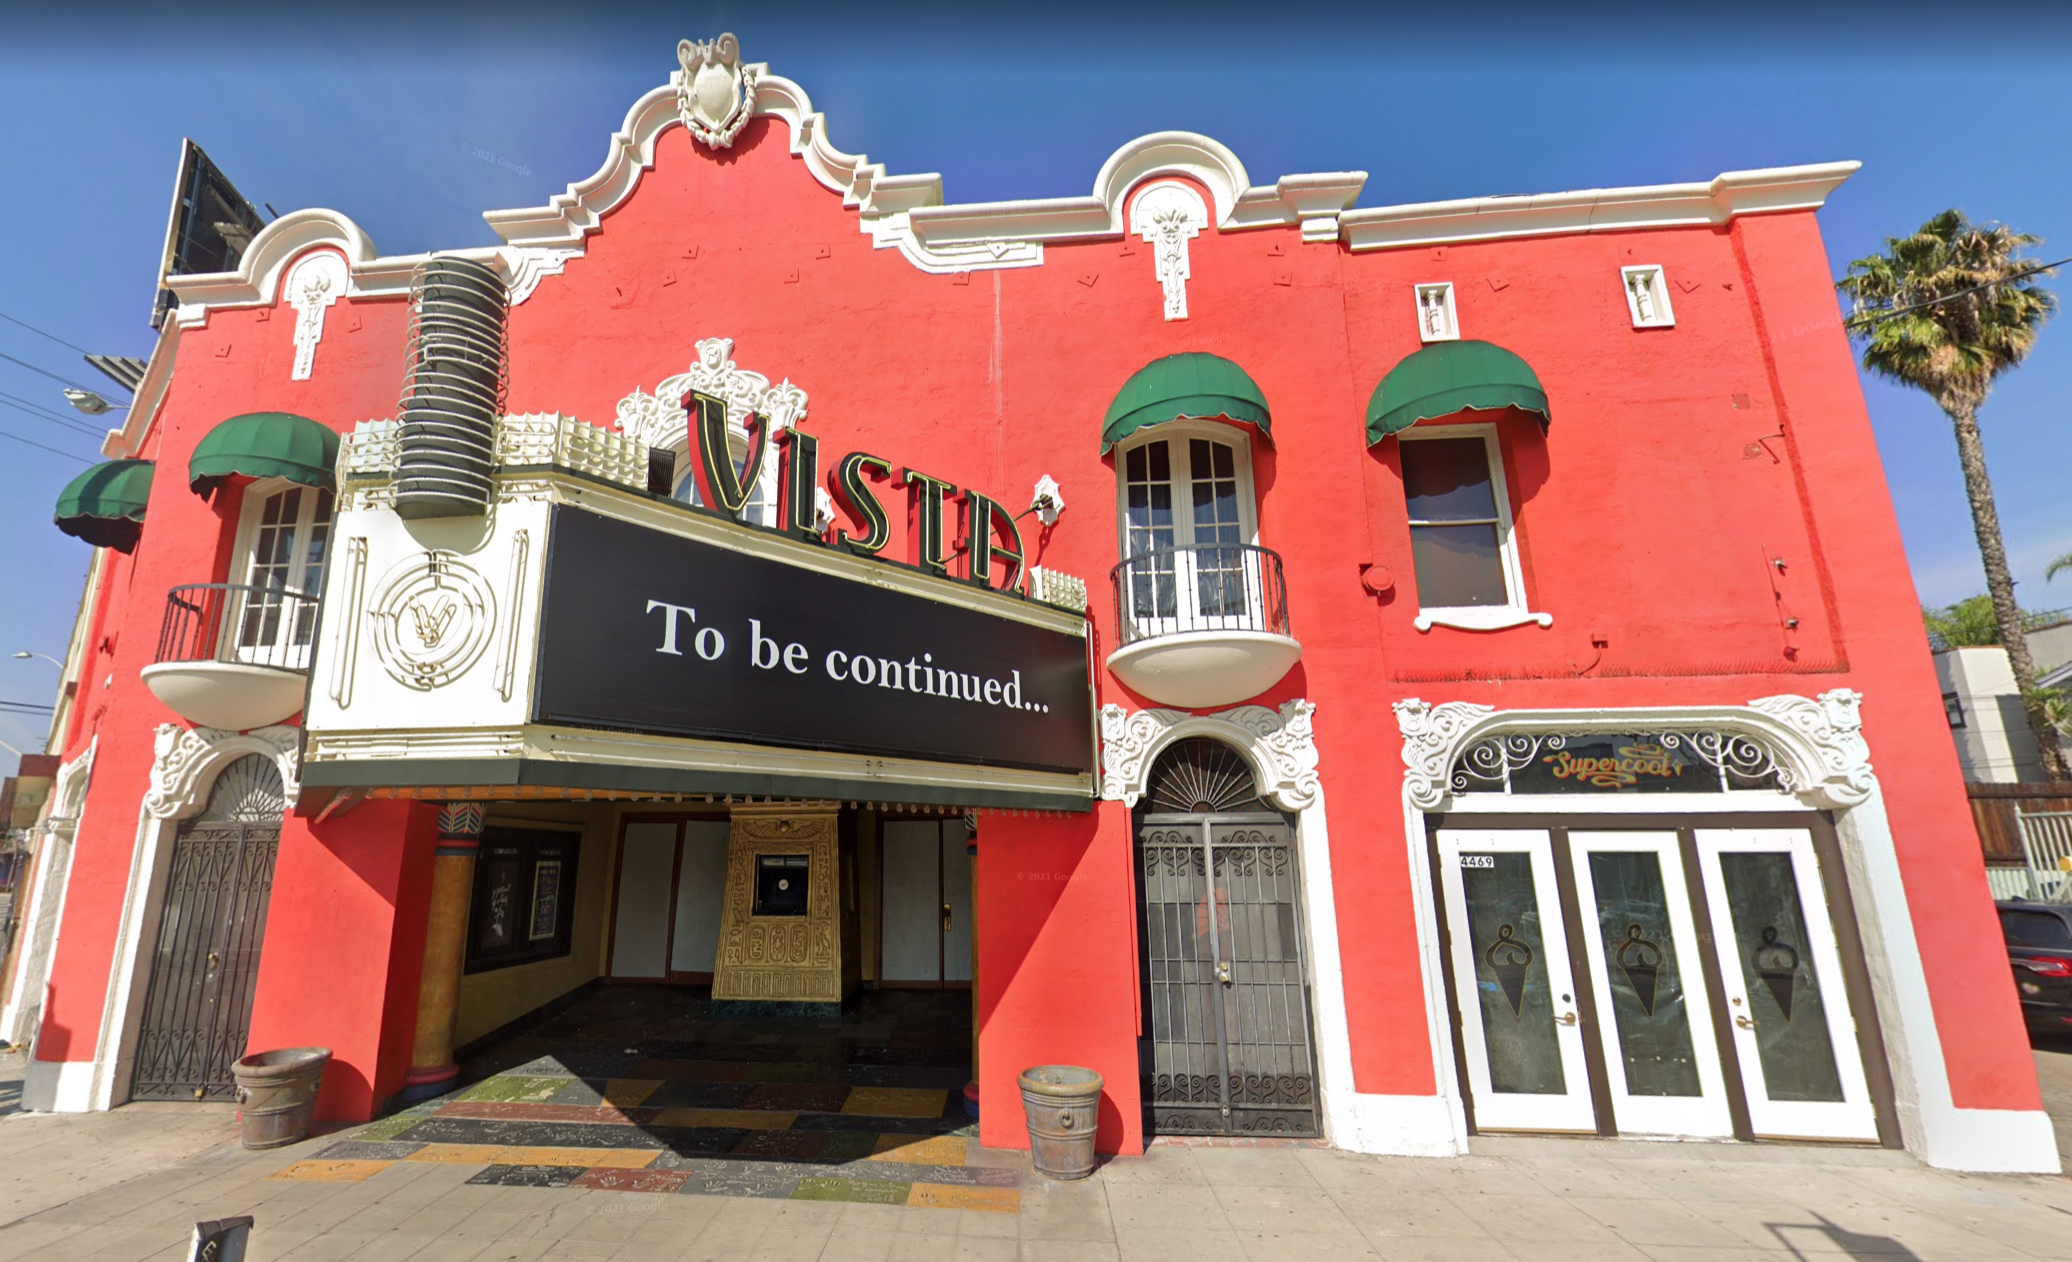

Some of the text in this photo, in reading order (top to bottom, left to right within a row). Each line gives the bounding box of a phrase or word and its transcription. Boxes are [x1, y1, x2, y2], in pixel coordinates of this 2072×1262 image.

[682, 389, 1024, 600] VISTA
[646, 599, 1050, 713] To be continued...
[1542, 742, 1672, 788] Supercool
[1461, 856, 1492, 867] 4469
